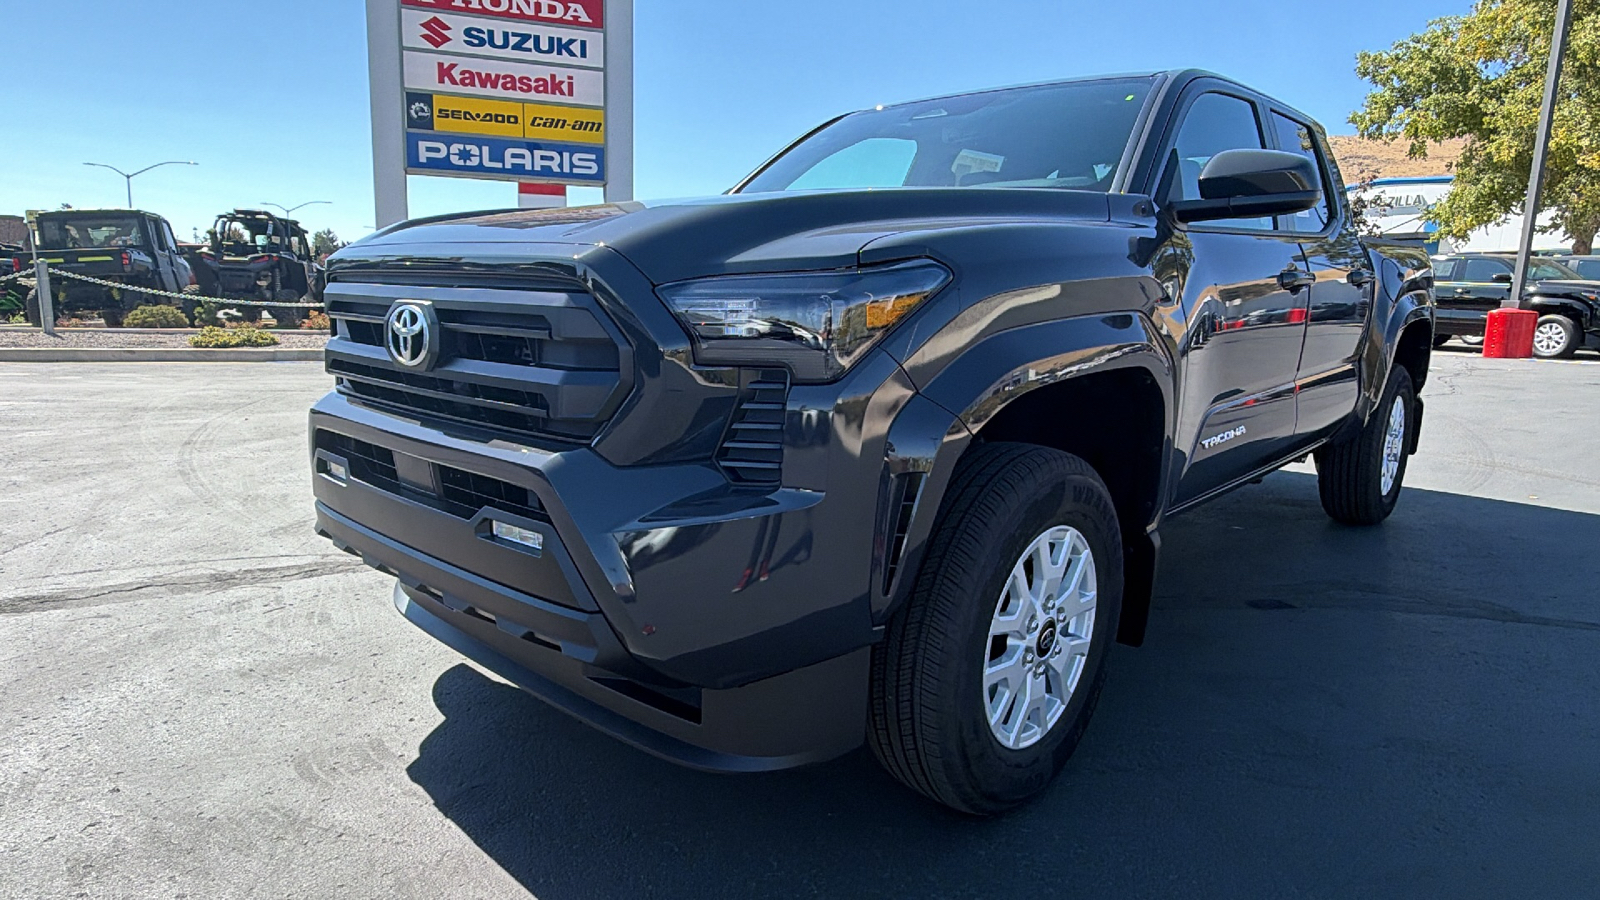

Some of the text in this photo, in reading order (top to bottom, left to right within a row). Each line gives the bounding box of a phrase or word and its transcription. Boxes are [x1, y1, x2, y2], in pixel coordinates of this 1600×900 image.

[463, 26, 587, 58] SUZUKI
[437, 62, 574, 97] Kawasaki
[418, 141, 598, 174] POLARIS
[1201, 425, 1246, 449] TACOMA
